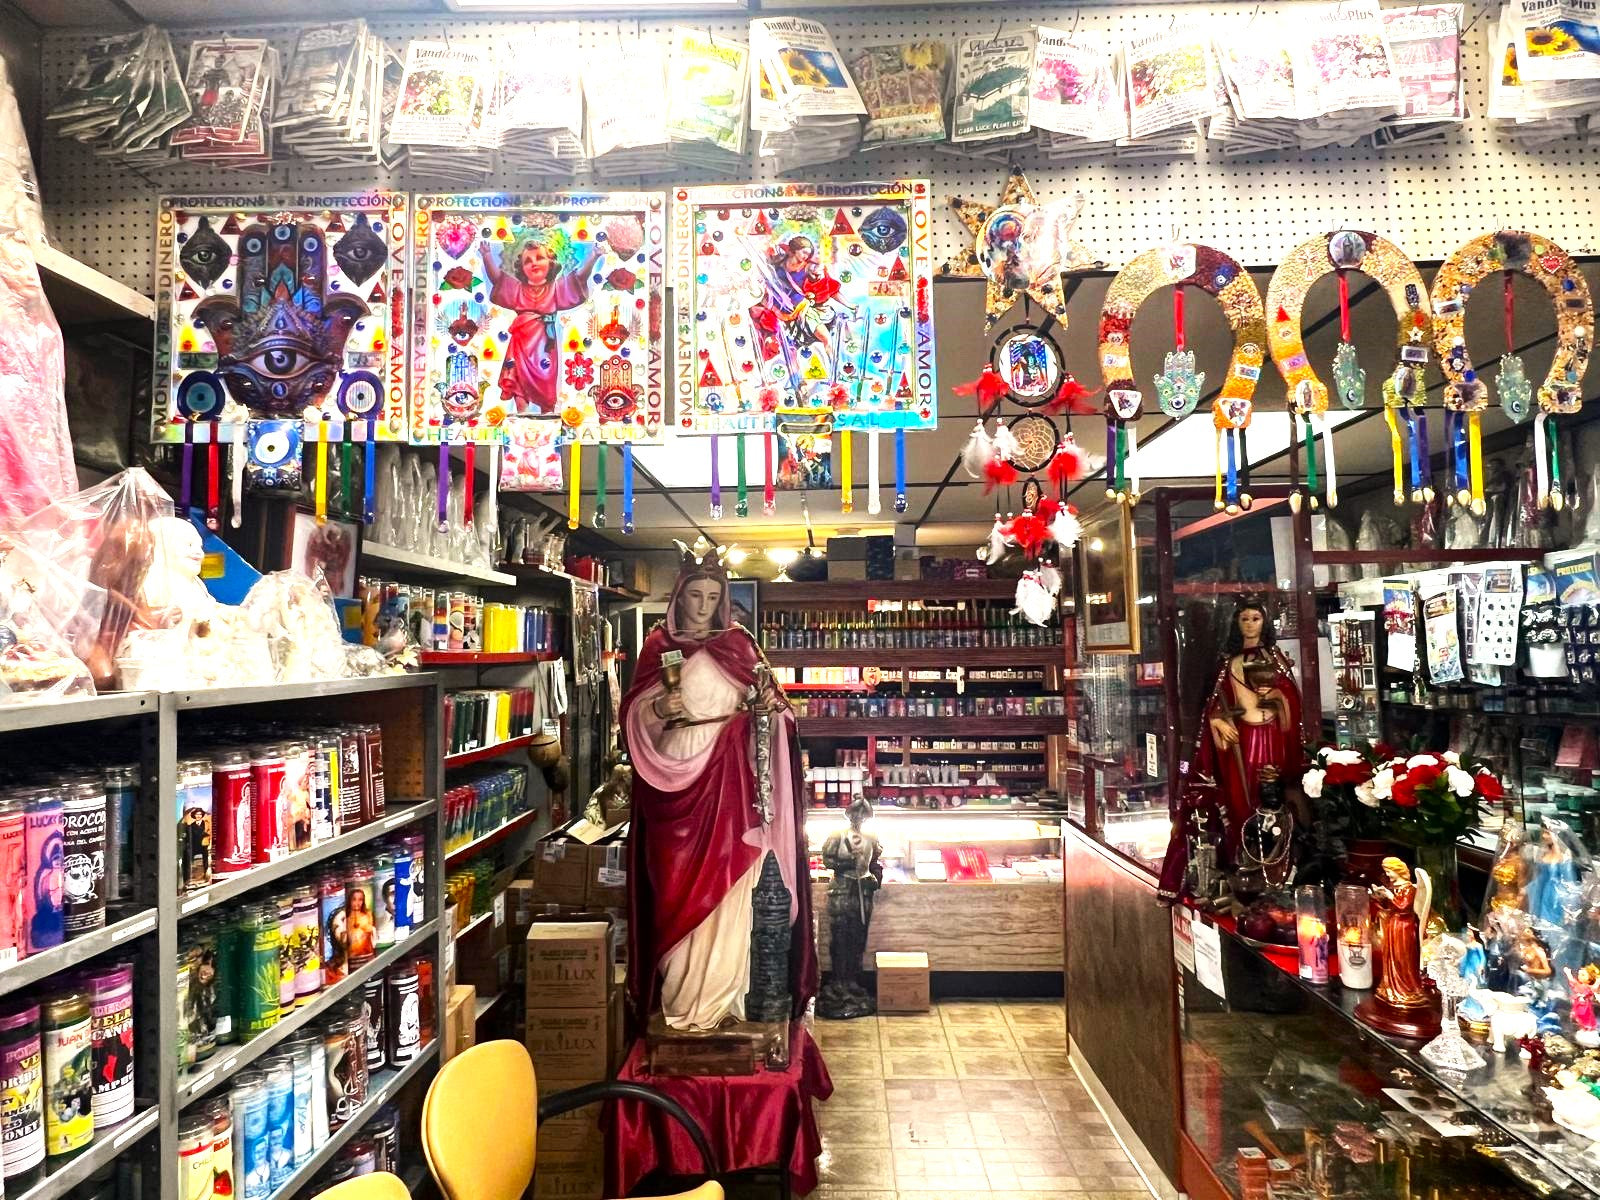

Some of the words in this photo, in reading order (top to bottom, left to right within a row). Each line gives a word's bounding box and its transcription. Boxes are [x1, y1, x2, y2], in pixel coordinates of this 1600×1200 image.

[1521, 0, 1558, 12] Vandi
[1571, 0, 1596, 10] Plus
[170, 196, 257, 208] PROTECTION
[304, 193, 392, 208] PROTECCIÓN
[430, 195, 513, 208] PROTECTION
[563, 194, 649, 207] PROTEIÓN
[824, 181, 913, 196] PROTECCIÓN
[158, 210, 172, 288] DINERO
[391, 206, 405, 284] LOVE
[413, 210, 429, 289] DINERO
[648, 208, 662, 287] LOVE
[676, 202, 690, 278] DINERO
[914, 195, 928, 268] LOVE
[154, 347, 170, 427] MONEY
[389, 344, 403, 420] AMOR
[413, 349, 427, 429] MONEY
[647, 349, 662, 426] AMOR
[677, 338, 693, 416] MONEY
[916, 331, 932, 410] AMOR
[567, 427, 645, 440] SALUD
[57, 1034, 83, 1048] JUAN
